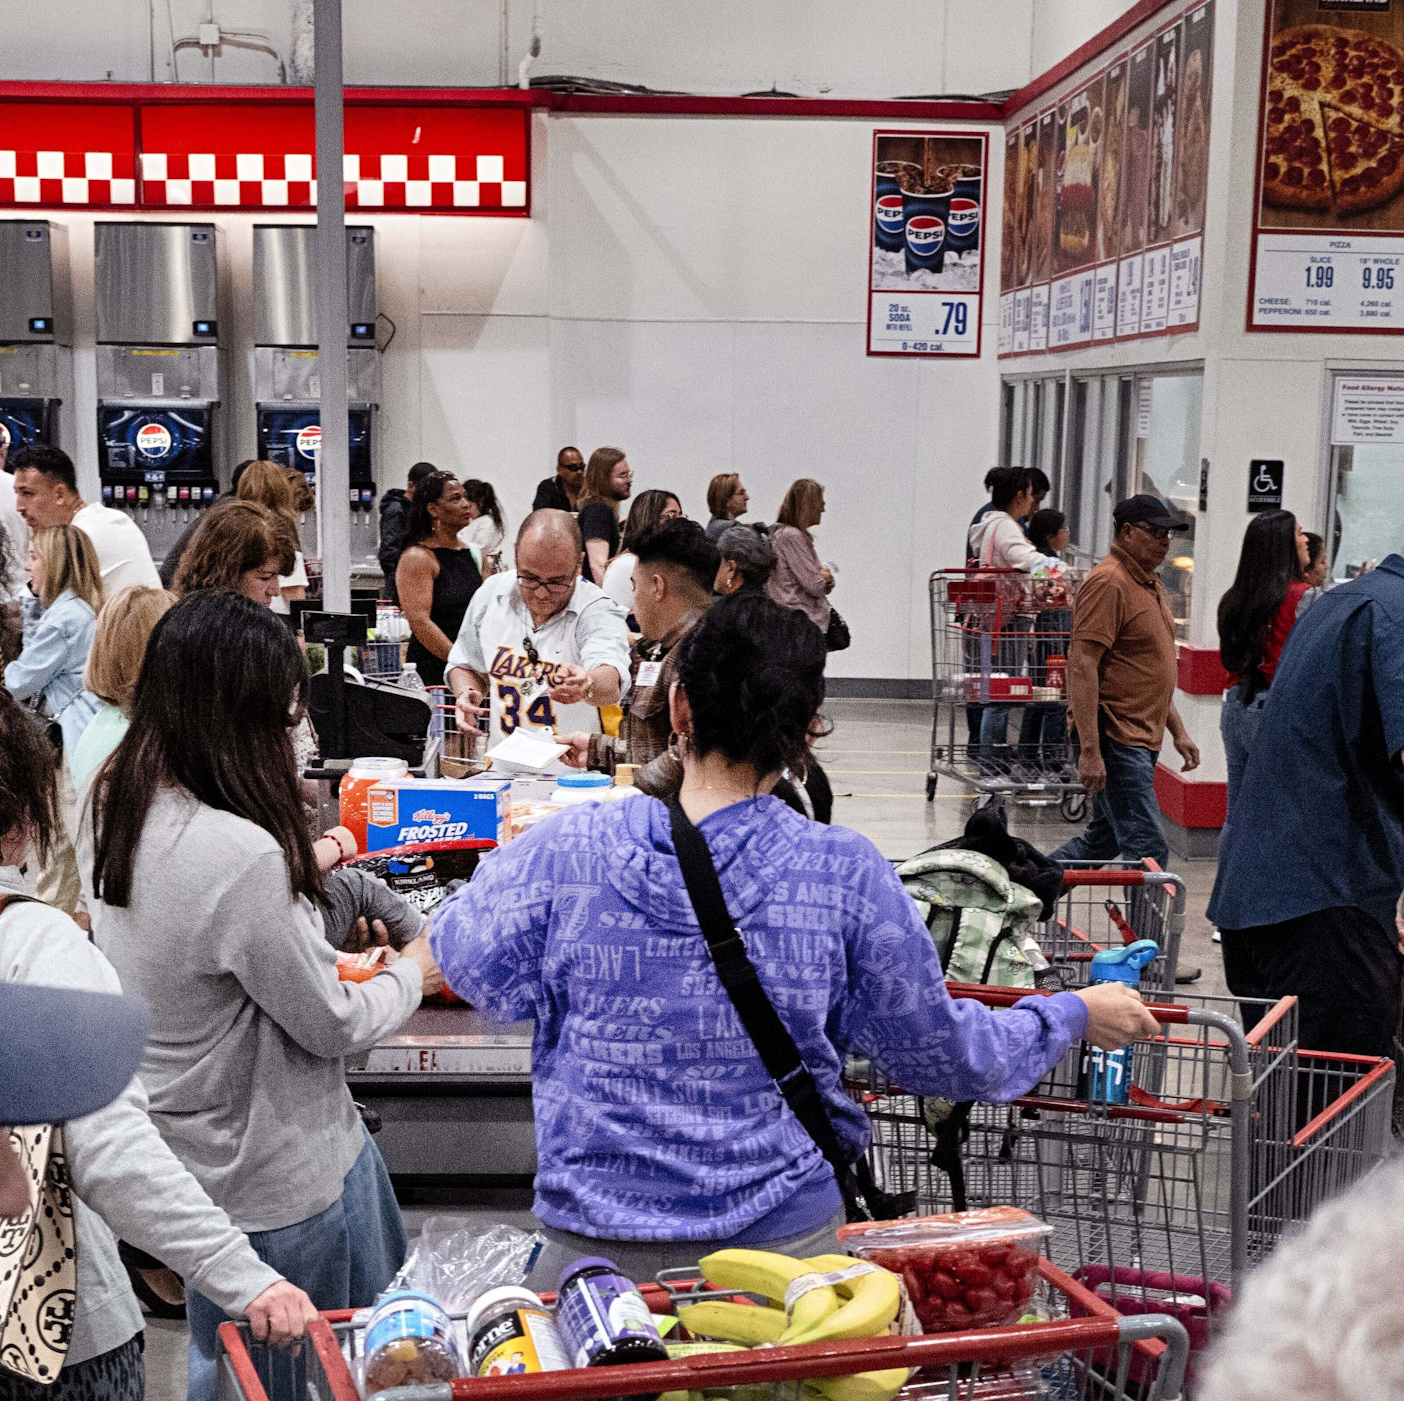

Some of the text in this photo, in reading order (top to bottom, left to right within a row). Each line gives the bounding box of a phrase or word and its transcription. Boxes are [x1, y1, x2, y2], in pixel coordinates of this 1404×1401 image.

[908, 230, 943, 240] PEPSI
[1306, 266, 1334, 287] 1.99
[1362, 267, 1394, 290] 9.95
[889, 303, 899, 312] 20
[889, 313, 910, 322] SODA
[935, 302, 967, 335] .79
[140, 437, 168, 445] PEPSI
[498, 682, 556, 736] 34
[412, 808, 451, 824] Kellogg's
[398, 822, 468, 841] FROSTED
